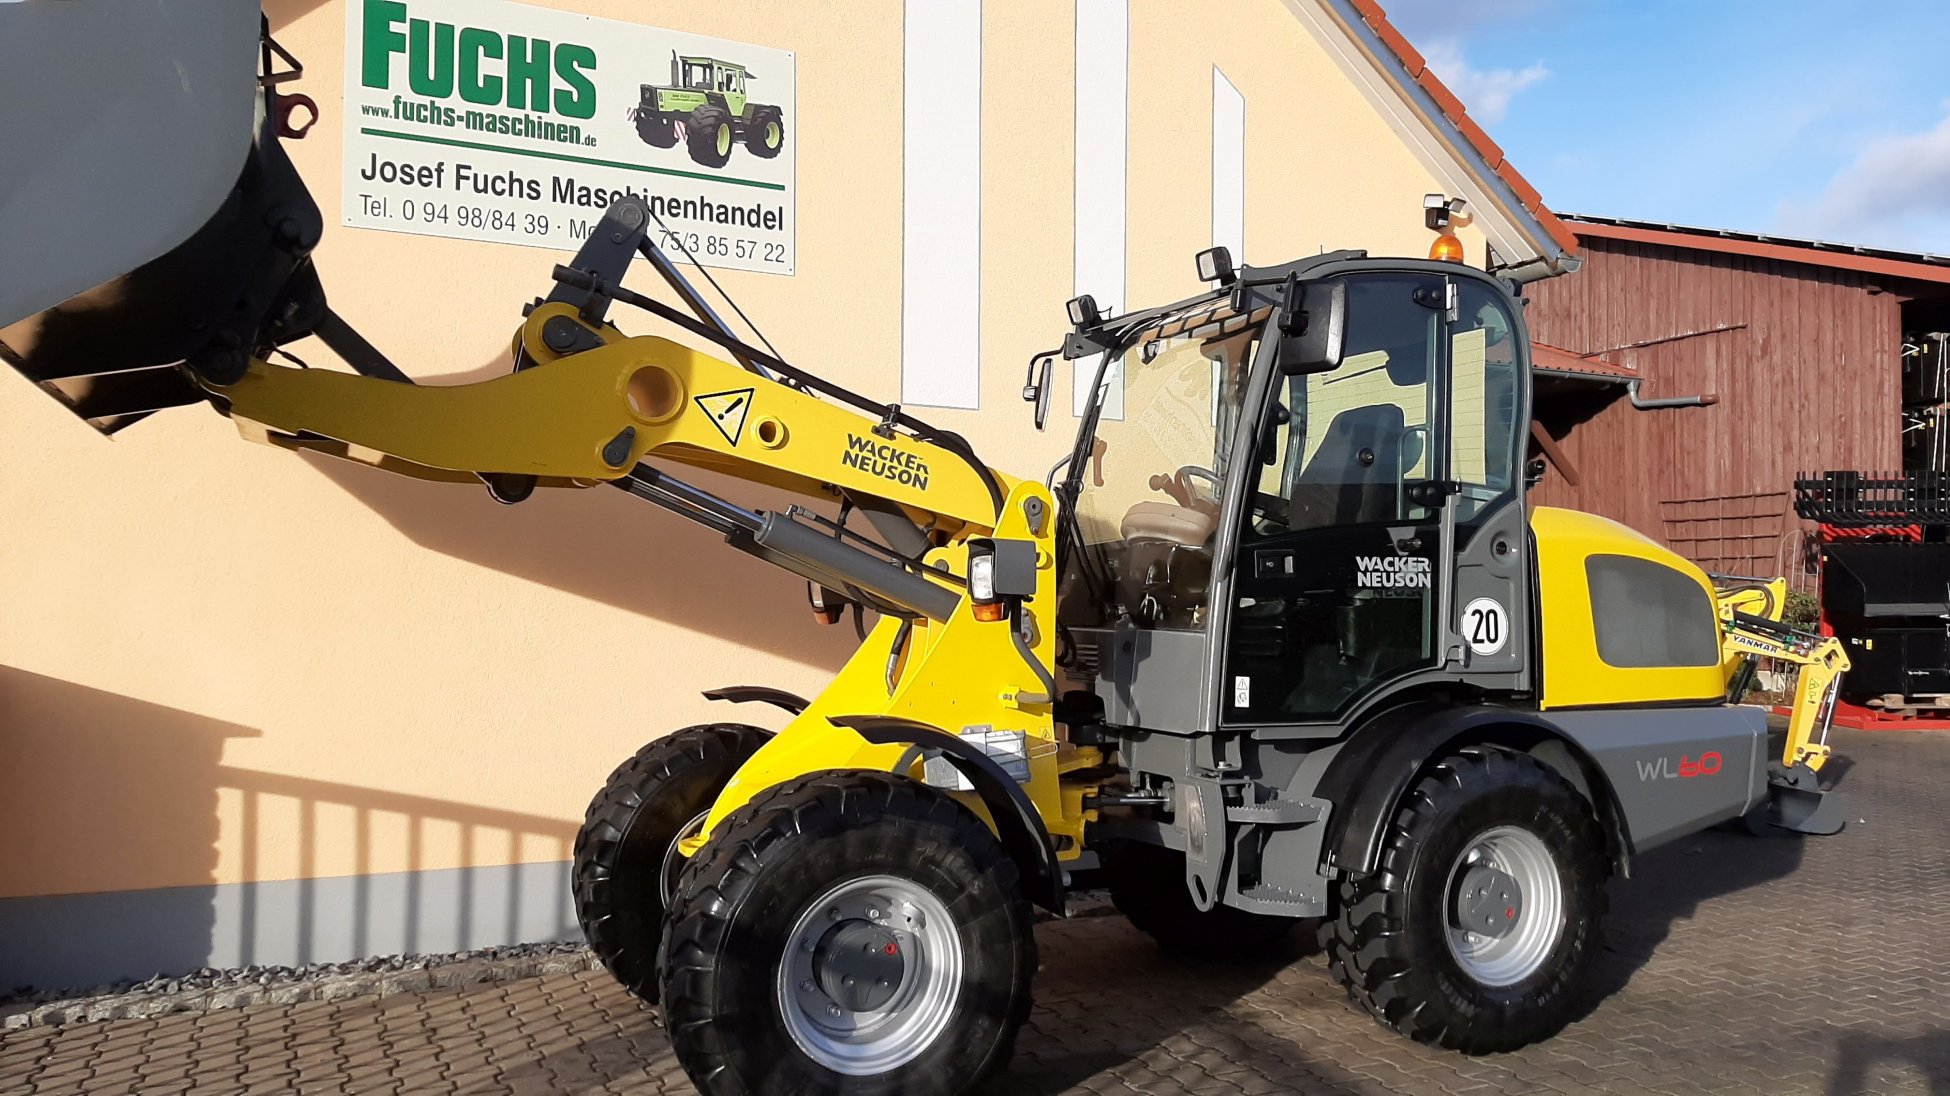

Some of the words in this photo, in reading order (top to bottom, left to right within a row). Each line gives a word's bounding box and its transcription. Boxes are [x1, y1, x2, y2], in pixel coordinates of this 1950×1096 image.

[362, 0, 597, 120] FUCHS
[360, 95, 597, 147] www.fuchs-maschinen.de
[360, 153, 445, 189] Josef
[455, 164, 541, 201] Fuchs
[359, 194, 394, 219] Tel.
[402, 200, 415, 221] 0
[423, 202, 449, 224] 94
[457, 206, 516, 231] 98/84
[524, 214, 549, 235] 39
[707, 236, 729, 256] 85
[735, 240, 757, 260] 57
[763, 243, 785, 263] 22
[842, 450, 928, 491] NEUSON
[847, 433, 928, 475] WACKER
[1355, 556, 1431, 572] WACKER
[1357, 571, 1431, 589] NEUSON
[1470, 608, 1499, 644] 20
[1733, 634, 1778, 654] YANMAR
